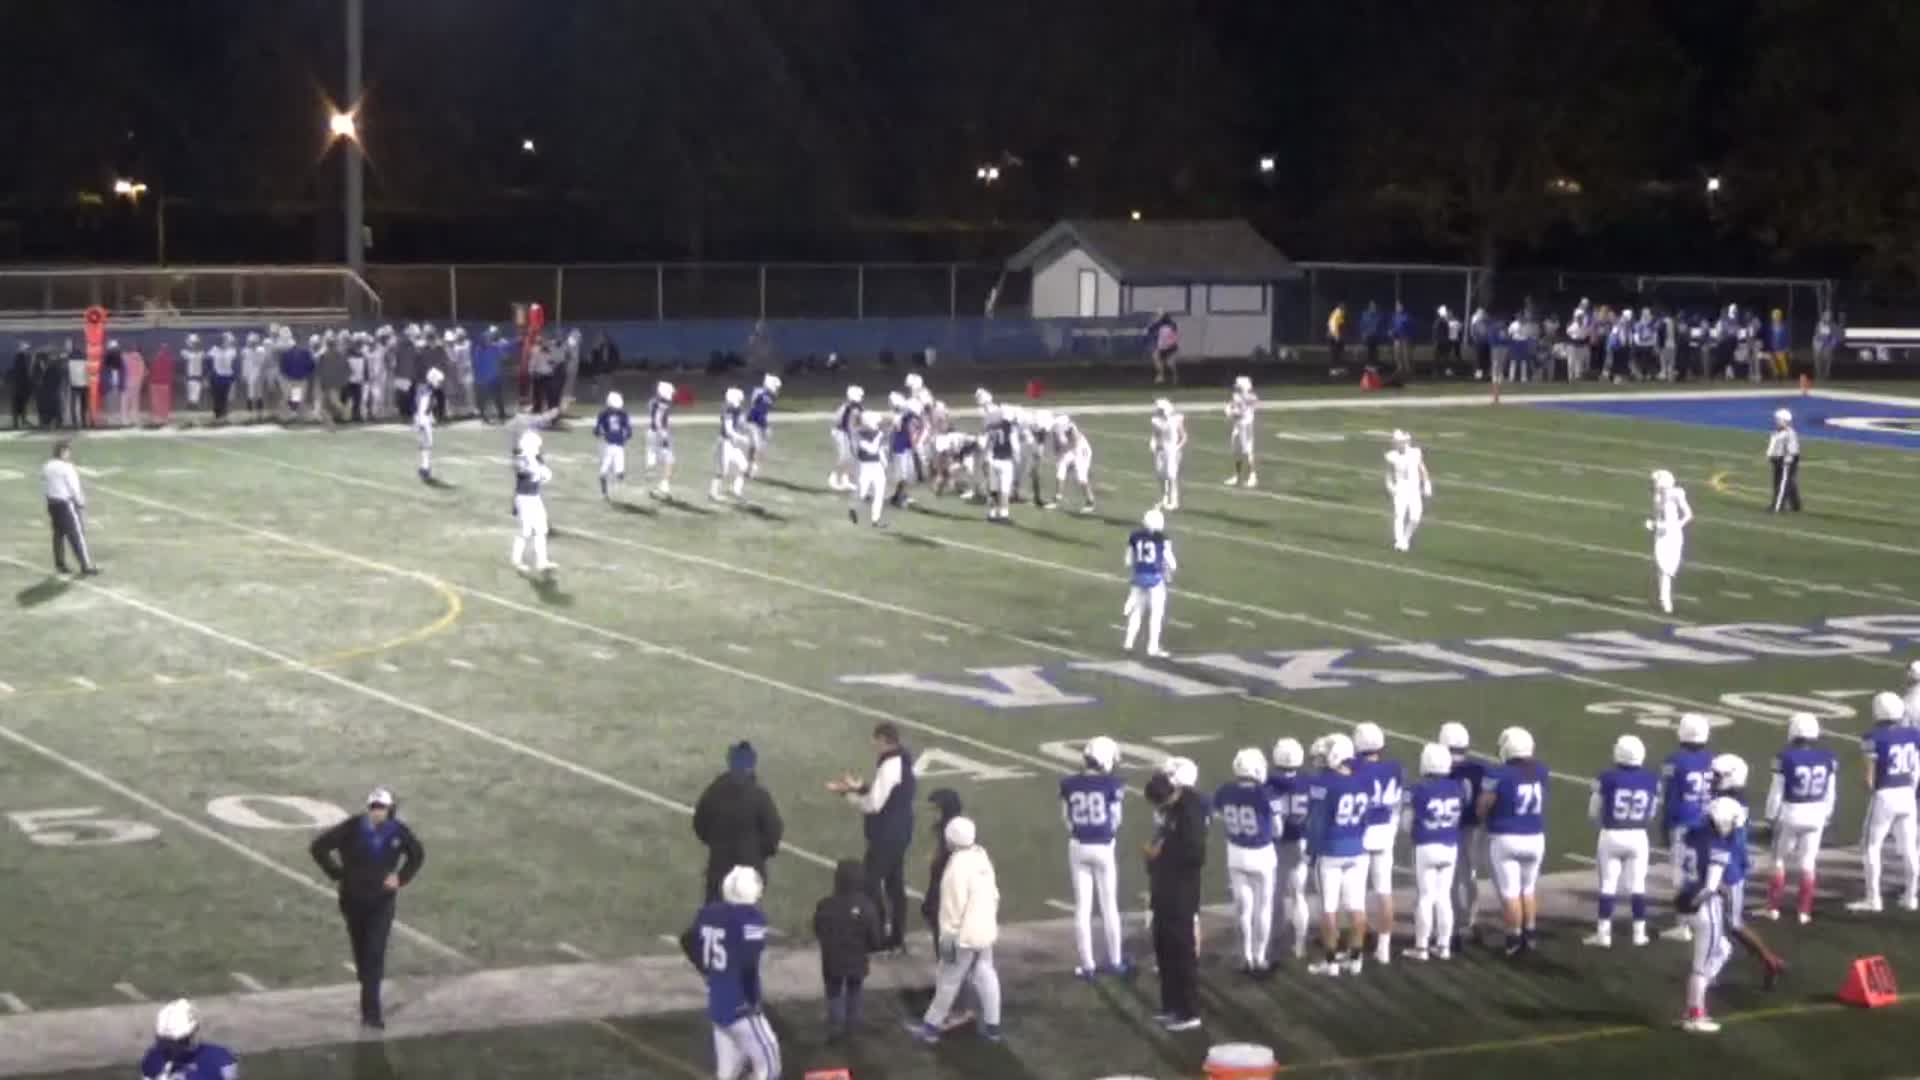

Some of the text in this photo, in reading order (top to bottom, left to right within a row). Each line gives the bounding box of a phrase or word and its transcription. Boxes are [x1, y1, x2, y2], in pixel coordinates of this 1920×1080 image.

[1136, 540, 1156, 563] 13
[1888, 743, 1916, 776] 30
[1515, 781, 1543, 815] 71
[1791, 765, 1827, 798] 32
[1069, 790, 1106, 826] 28
[1423, 797, 1461, 830] 35
[1612, 788, 1650, 821] 52
[701, 924, 728, 971] 75
